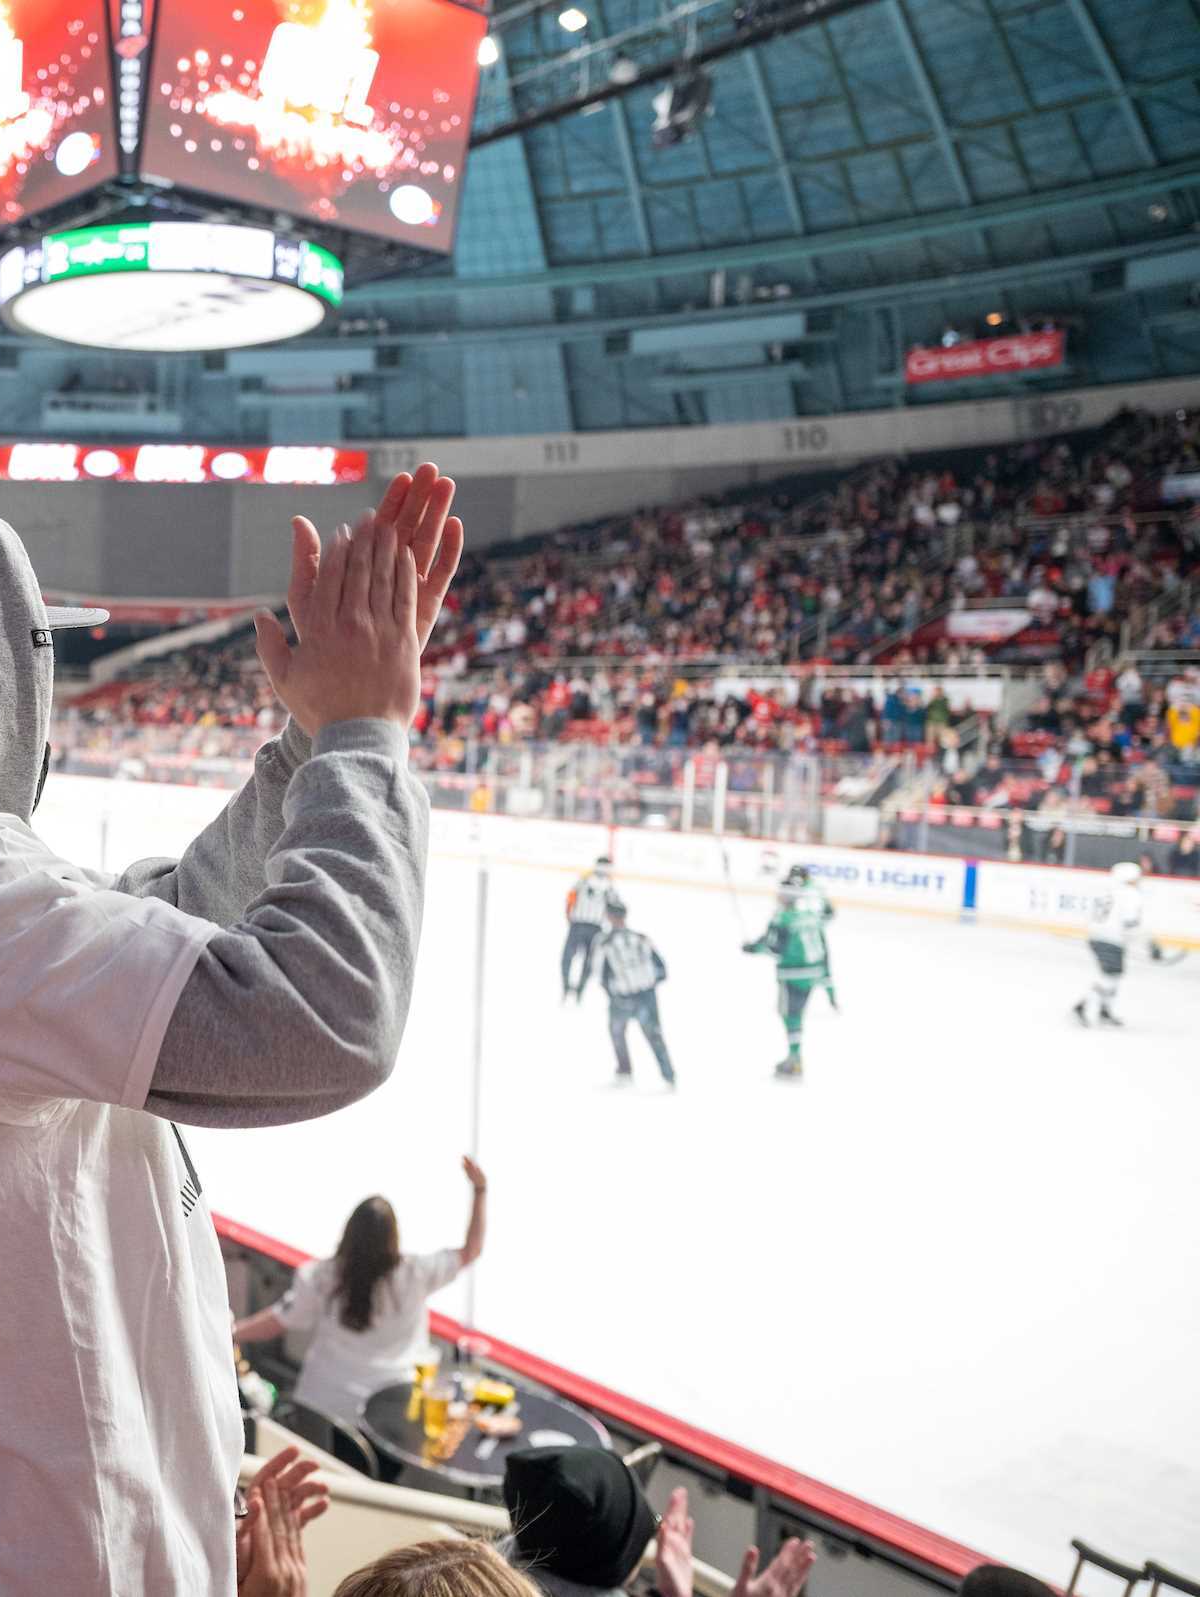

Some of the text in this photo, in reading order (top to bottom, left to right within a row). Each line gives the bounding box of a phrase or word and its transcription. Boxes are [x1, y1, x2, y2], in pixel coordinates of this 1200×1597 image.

[907, 339, 1055, 376] Great Clips
[783, 424, 827, 450] 110
[544, 441, 579, 462] 111
